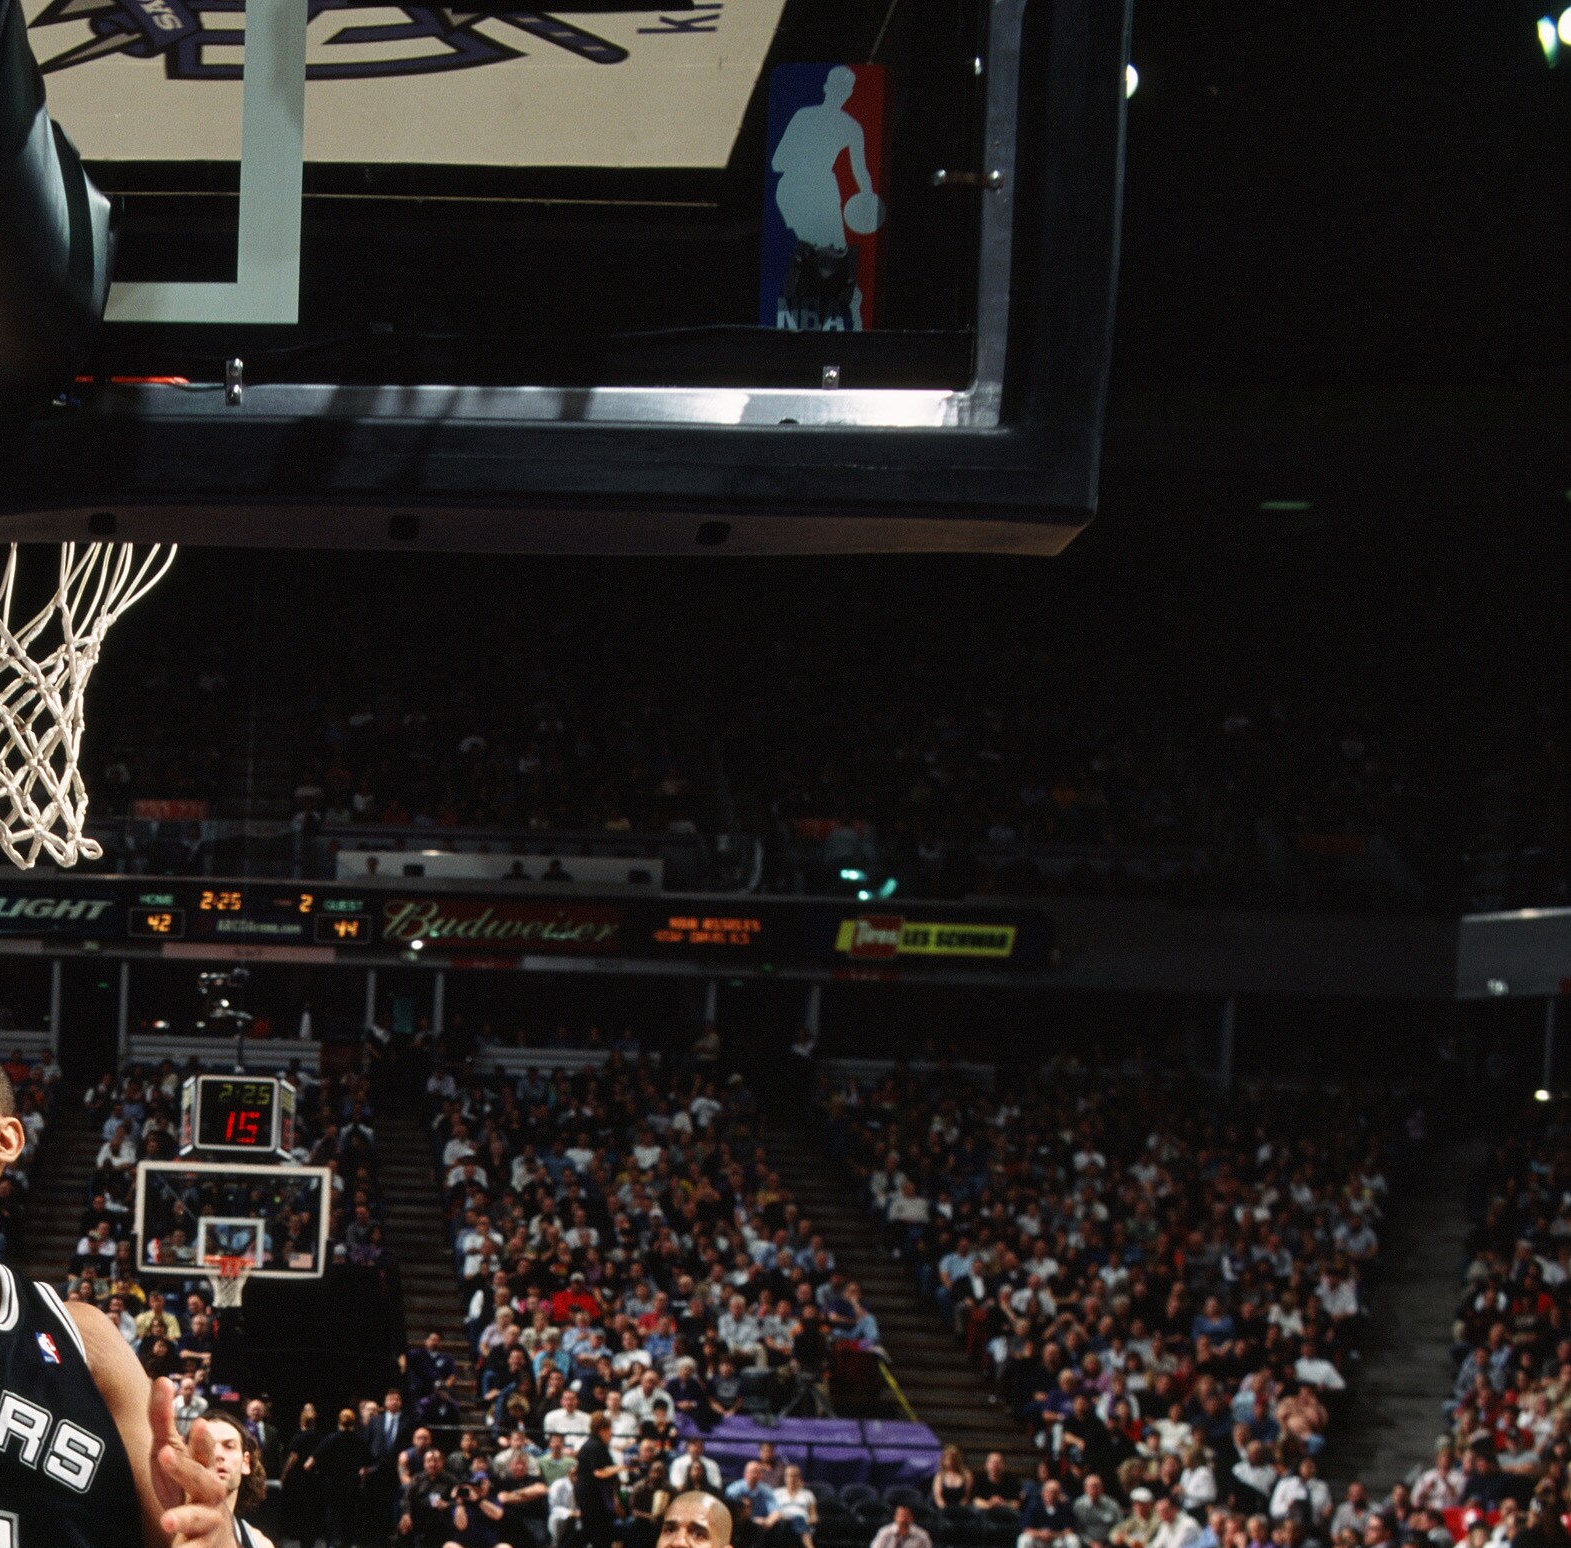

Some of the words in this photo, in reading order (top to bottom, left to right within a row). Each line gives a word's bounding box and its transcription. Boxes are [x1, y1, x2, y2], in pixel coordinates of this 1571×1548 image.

[298, 892, 316, 914] 2
[146, 912, 174, 935] 42
[332, 918, 361, 940] 44
[382, 901, 620, 943] Budweiser
[225, 1110, 262, 1144] 15
